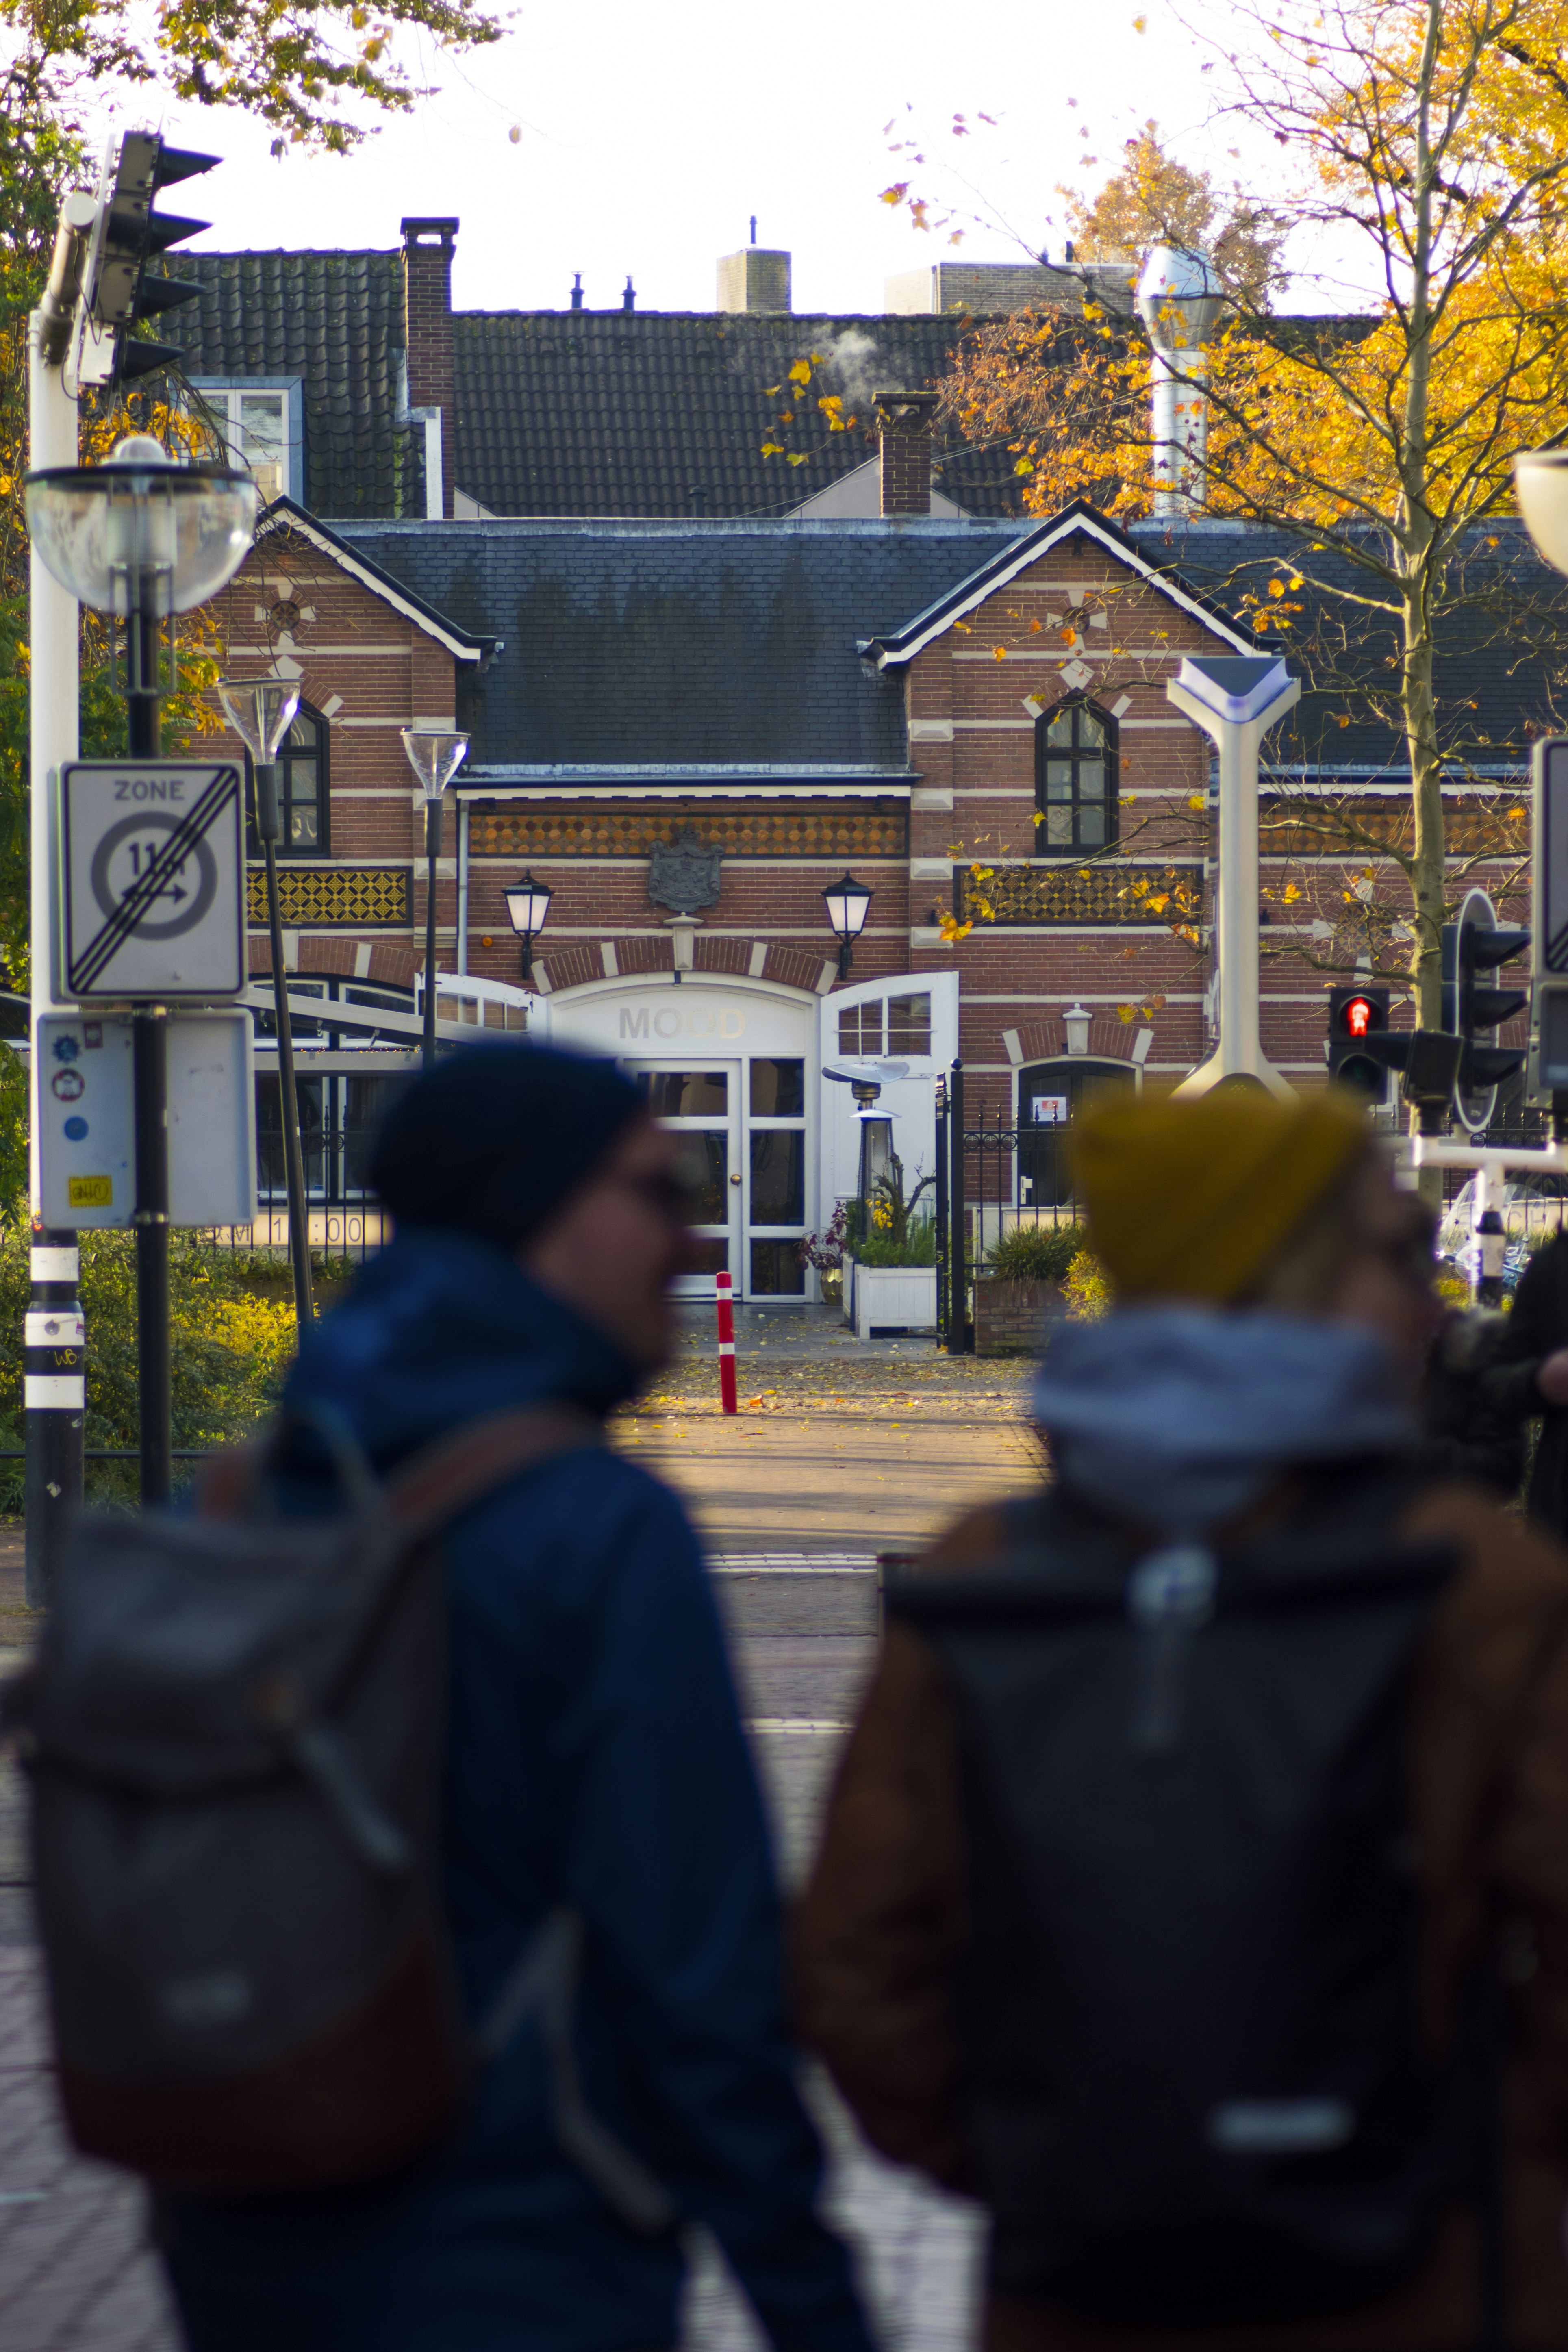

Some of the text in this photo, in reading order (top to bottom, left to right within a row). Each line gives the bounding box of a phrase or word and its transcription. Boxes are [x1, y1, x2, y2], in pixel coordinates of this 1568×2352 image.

[114, 780, 185, 801] ZONE
[619, 1008, 746, 1039] MOOD
[273, 1217, 361, 1242] 1:00
